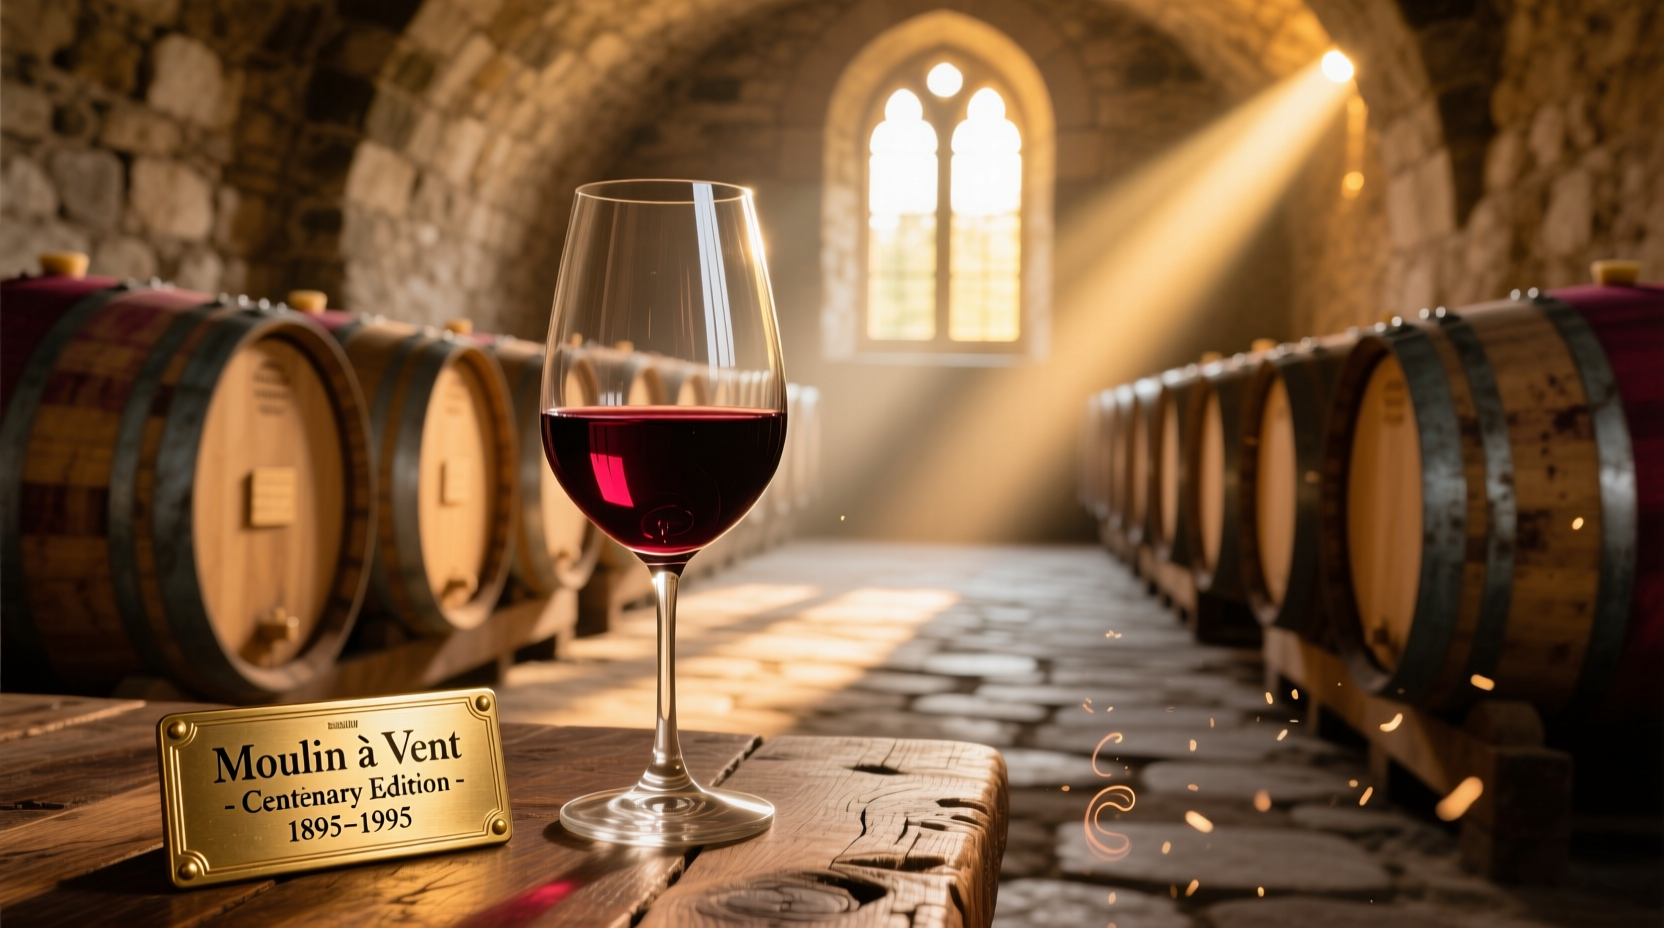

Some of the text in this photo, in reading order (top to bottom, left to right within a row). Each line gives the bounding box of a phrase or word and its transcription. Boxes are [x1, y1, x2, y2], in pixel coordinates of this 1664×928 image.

[211, 729, 463, 784] Moulin à Vent
[368, 772, 451, 801] Edition
